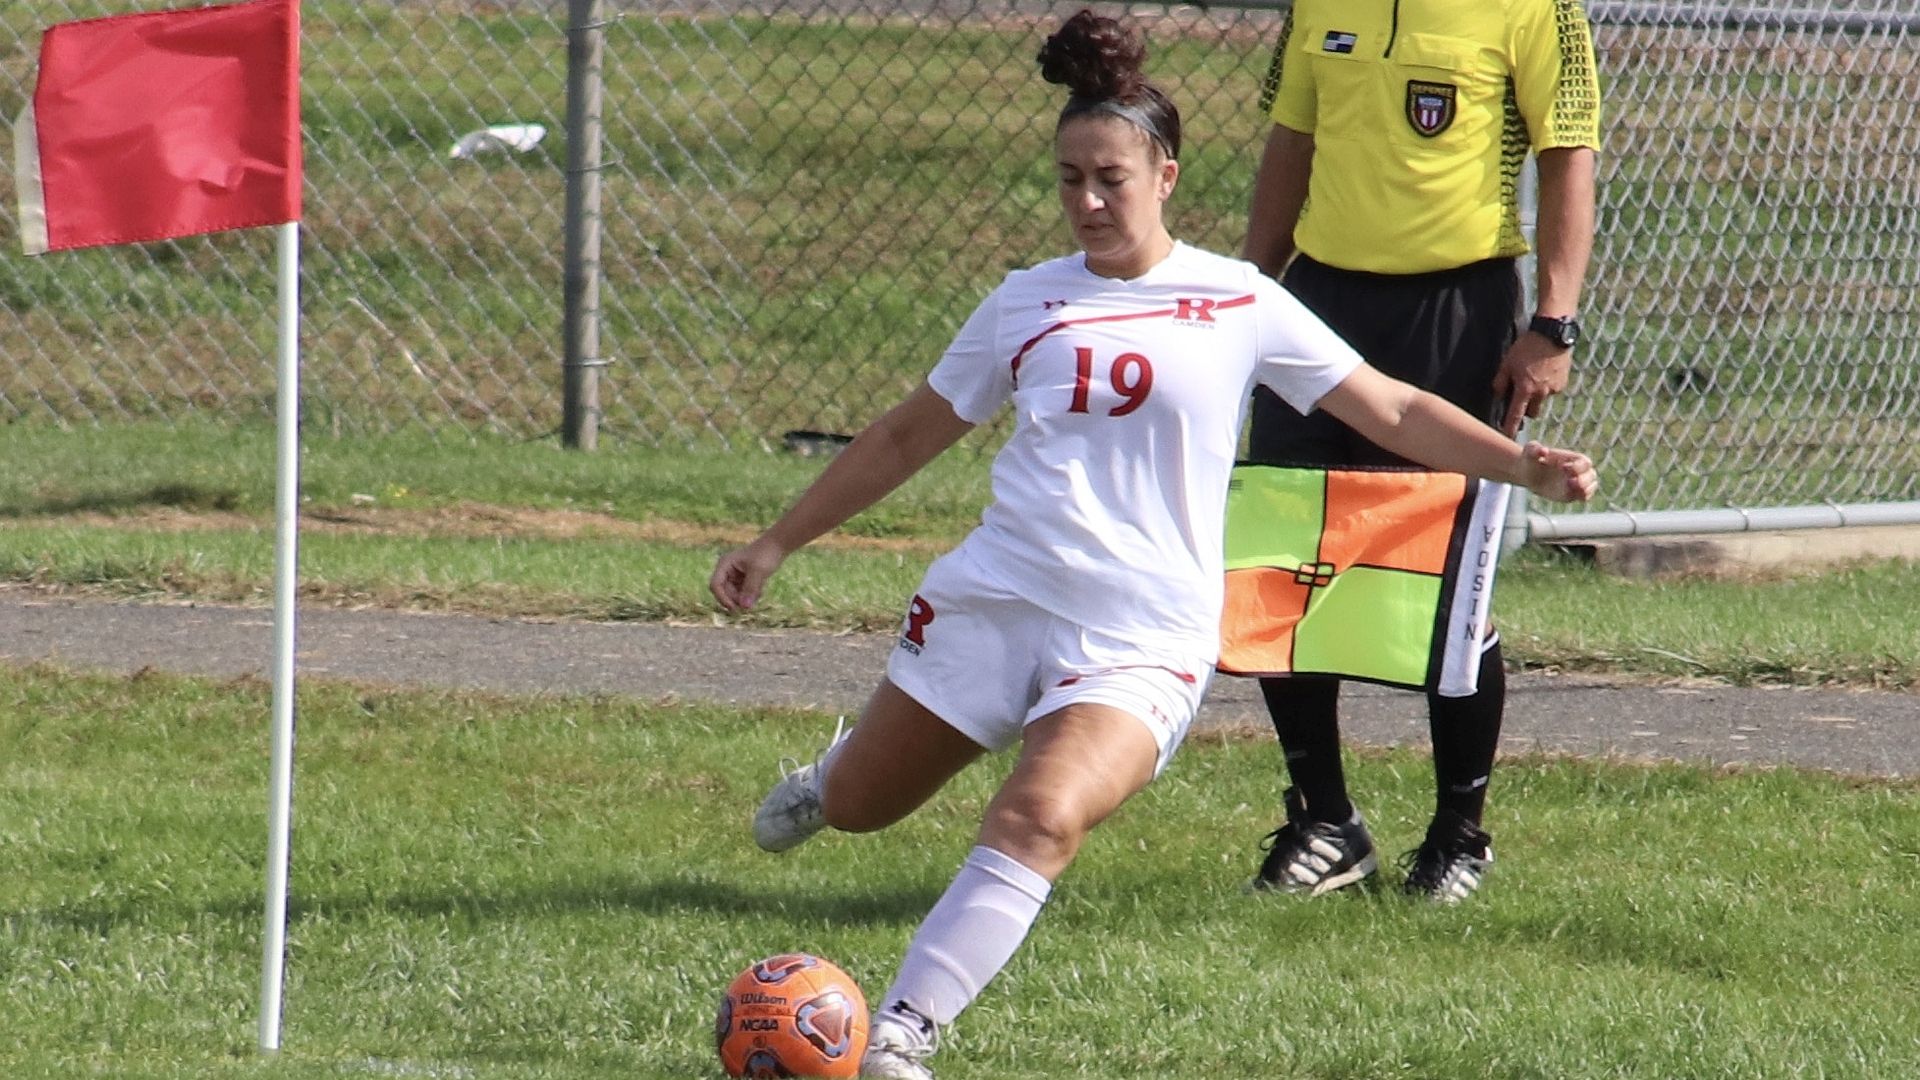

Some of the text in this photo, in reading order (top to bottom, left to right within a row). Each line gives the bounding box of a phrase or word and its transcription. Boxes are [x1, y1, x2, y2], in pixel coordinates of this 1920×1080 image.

[1174, 298, 1216, 322] R
[1172, 319, 1215, 330] CAMDEN
[1068, 346, 1153, 417] 19
[741, 993, 787, 1004] Wilson
[740, 1019, 779, 1032] NCAA
